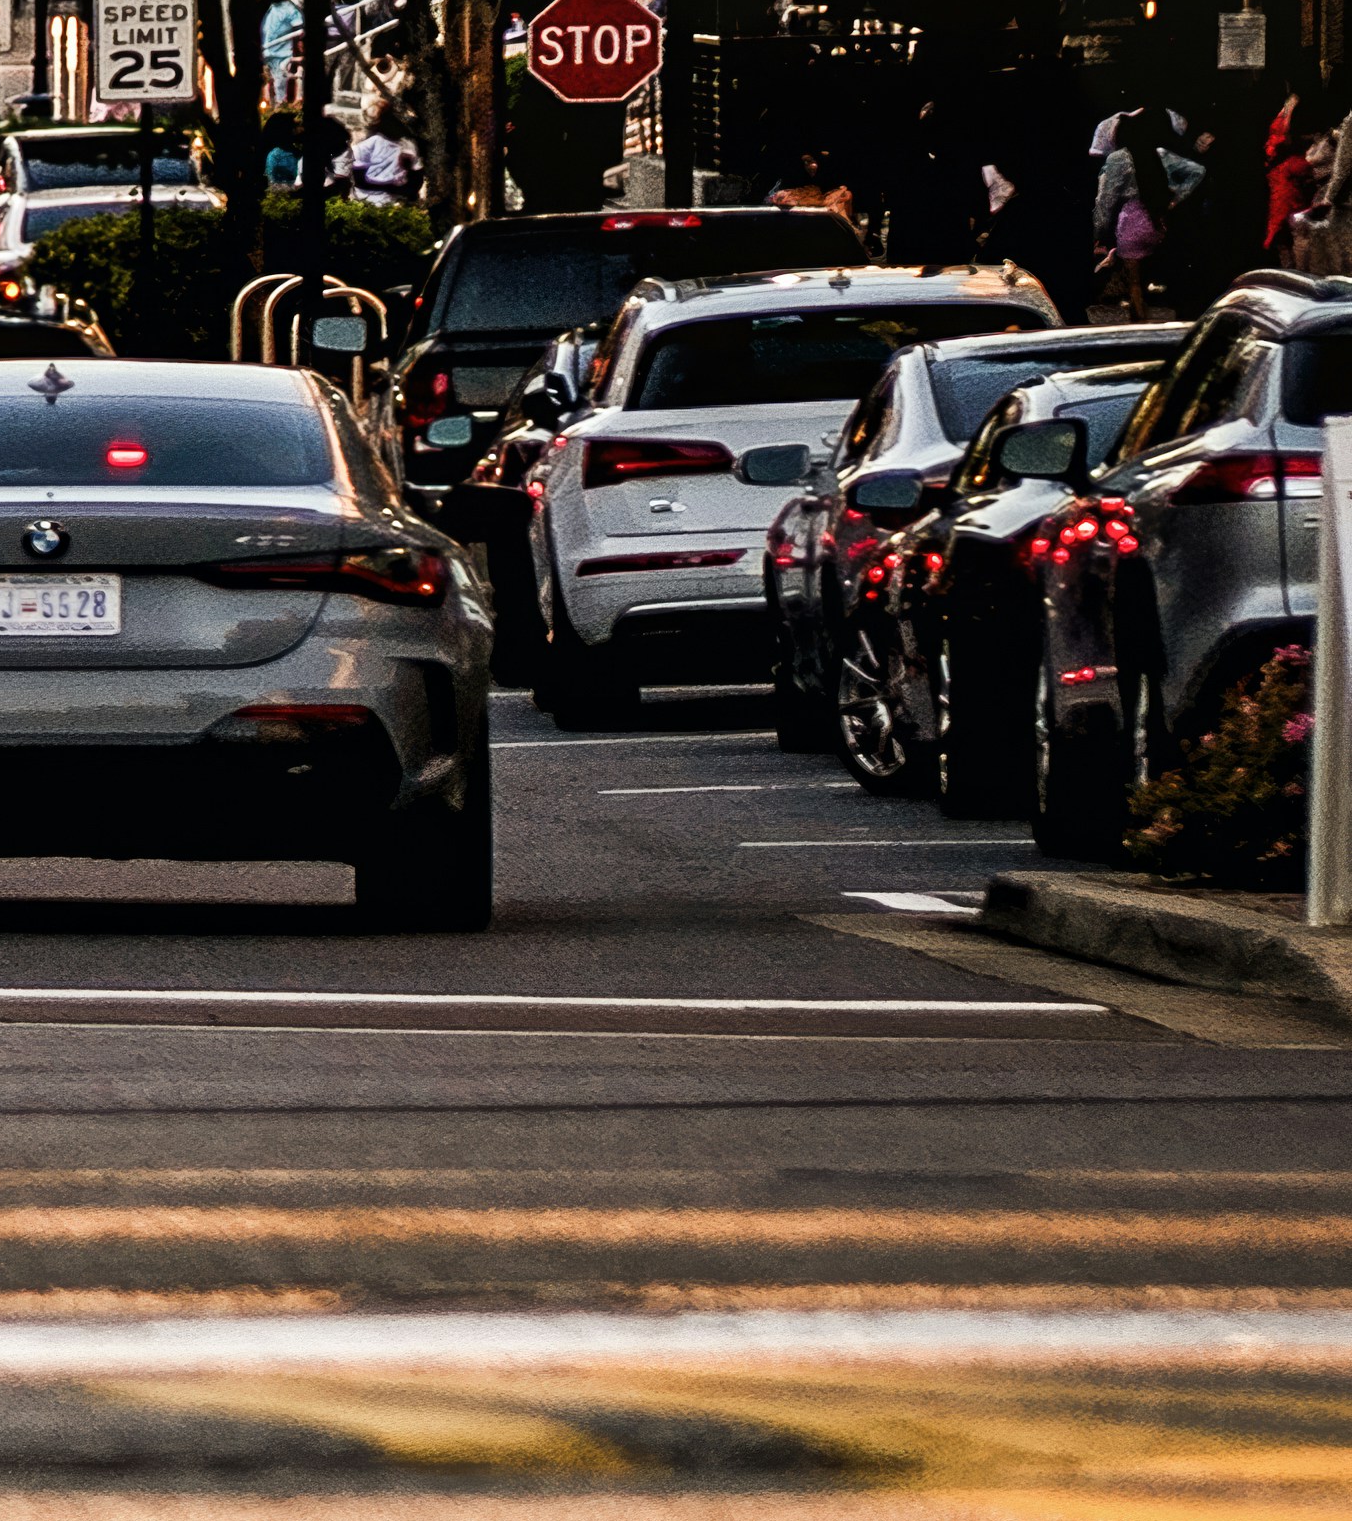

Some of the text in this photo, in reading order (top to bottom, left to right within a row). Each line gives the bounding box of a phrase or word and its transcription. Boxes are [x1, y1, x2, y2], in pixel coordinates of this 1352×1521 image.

[103, 4, 188, 24] SPEED
[112, 27, 178, 46] LIMIT
[538, 24, 652, 66] STOP
[108, 49, 184, 89] 25
